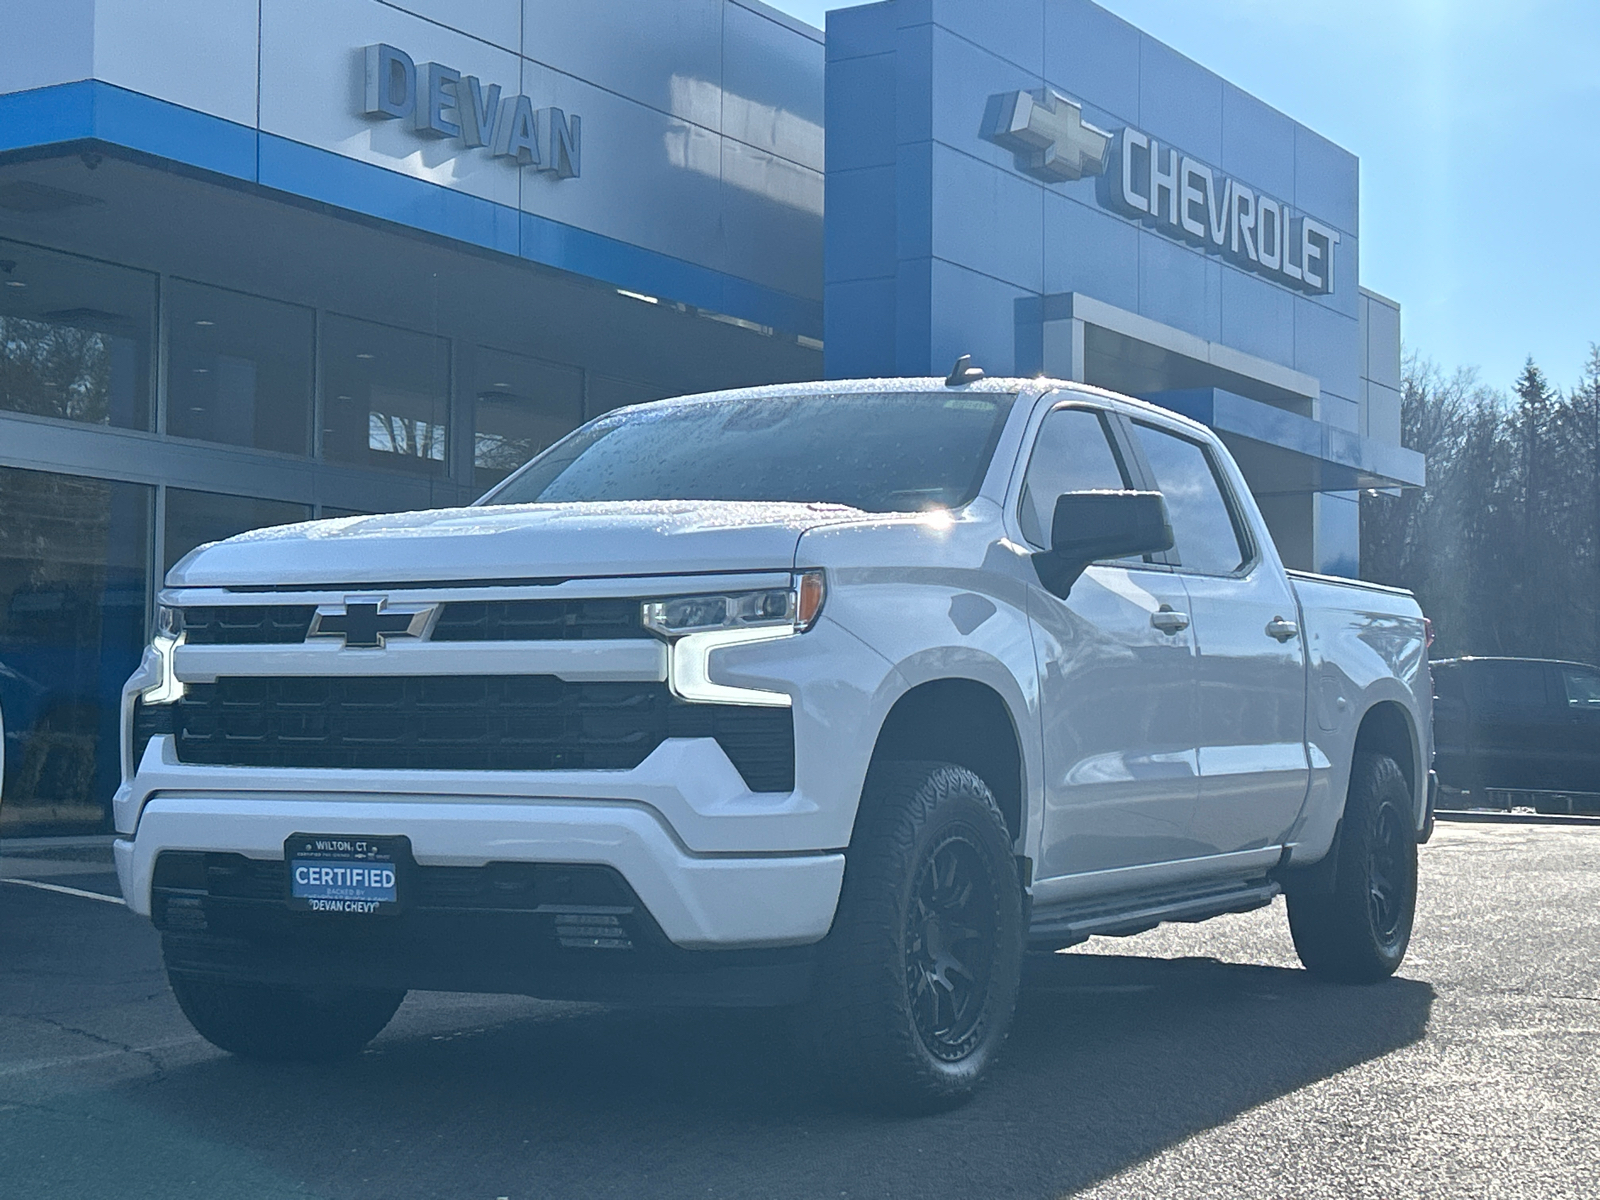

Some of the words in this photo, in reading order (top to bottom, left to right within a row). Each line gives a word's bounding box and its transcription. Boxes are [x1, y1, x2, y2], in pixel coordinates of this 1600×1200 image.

[365, 43, 581, 179] DEVAN
[1121, 126, 1341, 294] CHEVROLET
[316, 841, 354, 851] WILTON,
[356, 842, 367, 851] CT
[296, 867, 396, 888] CERTIFIED
[313, 900, 343, 911] DEVAN
[345, 901, 375, 913] CHEVY
